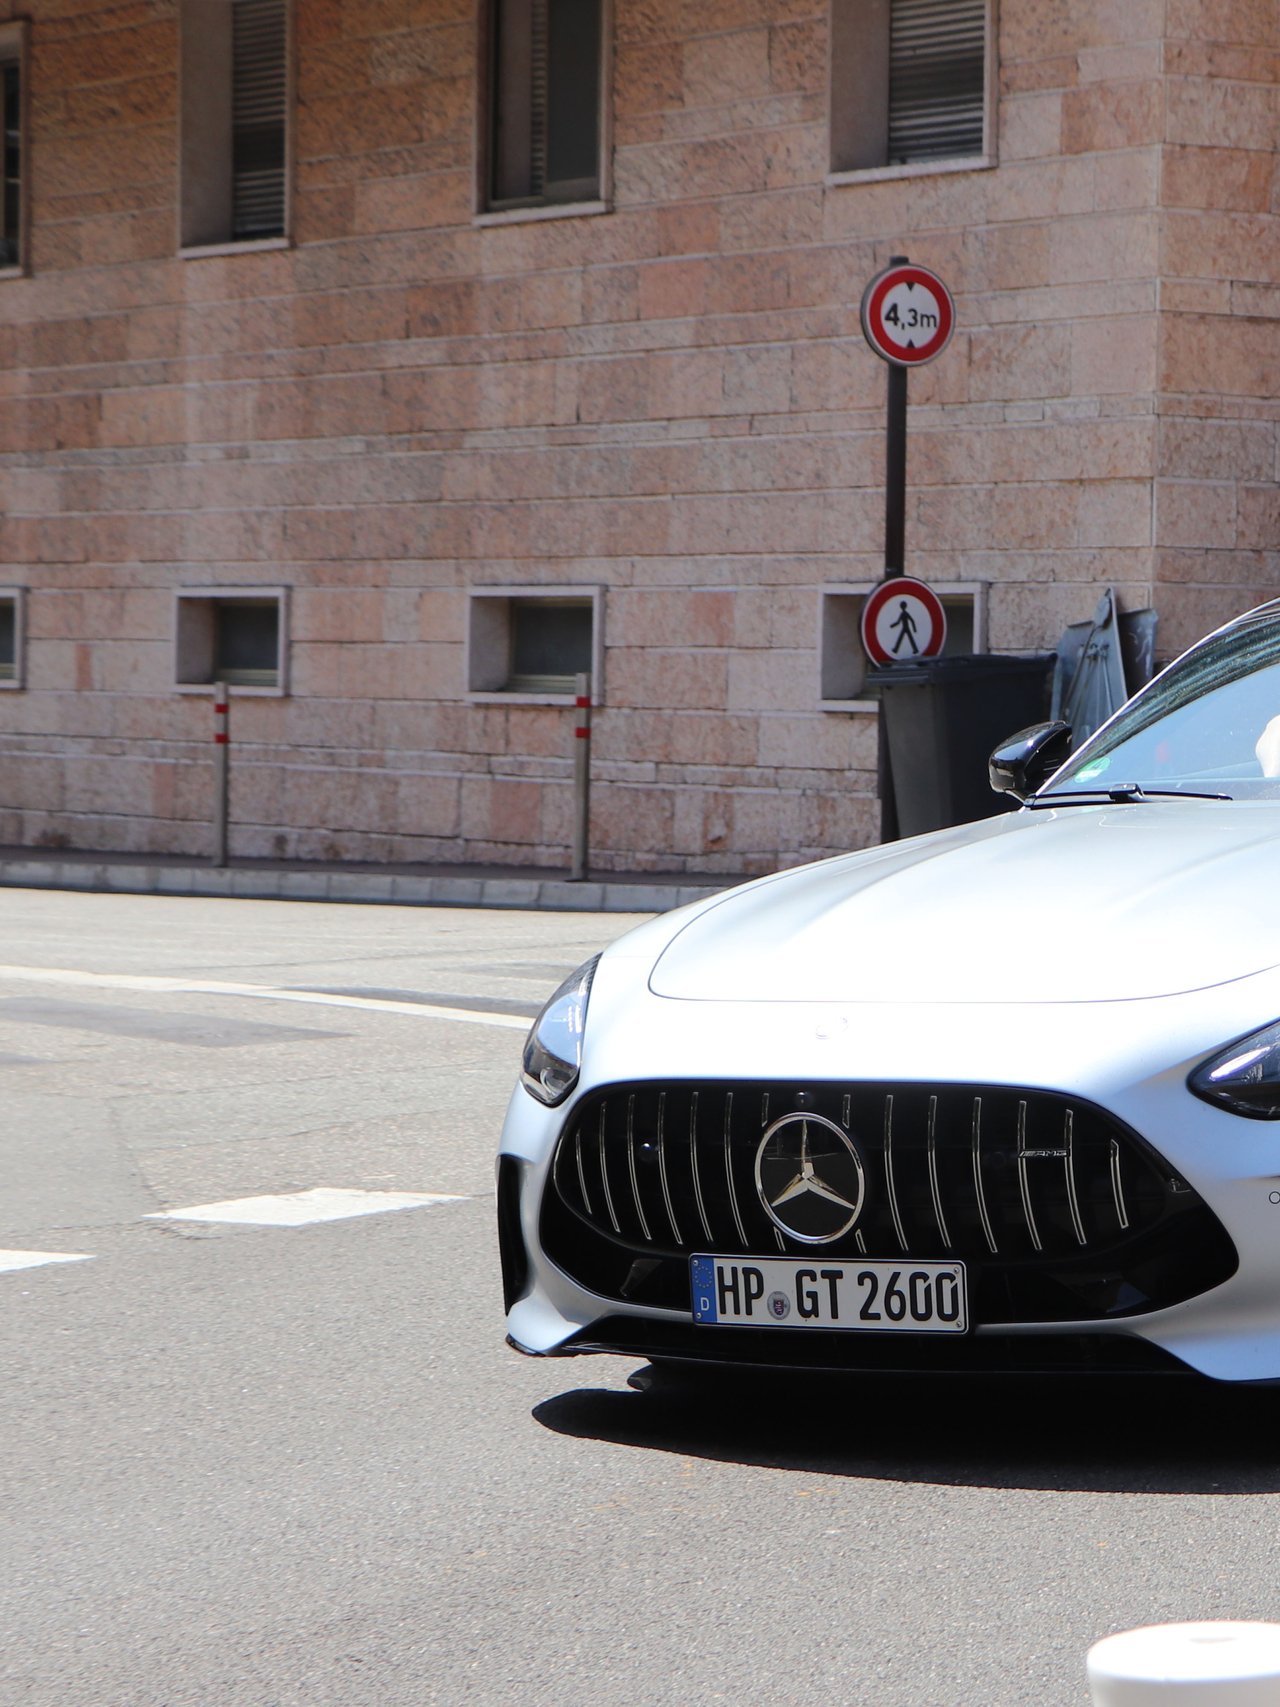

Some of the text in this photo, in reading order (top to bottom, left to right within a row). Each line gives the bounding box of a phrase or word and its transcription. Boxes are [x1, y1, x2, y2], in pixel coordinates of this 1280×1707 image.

[885, 303, 937, 330] 4,3m
[700, 1265, 960, 1322] D HP GT 2600
